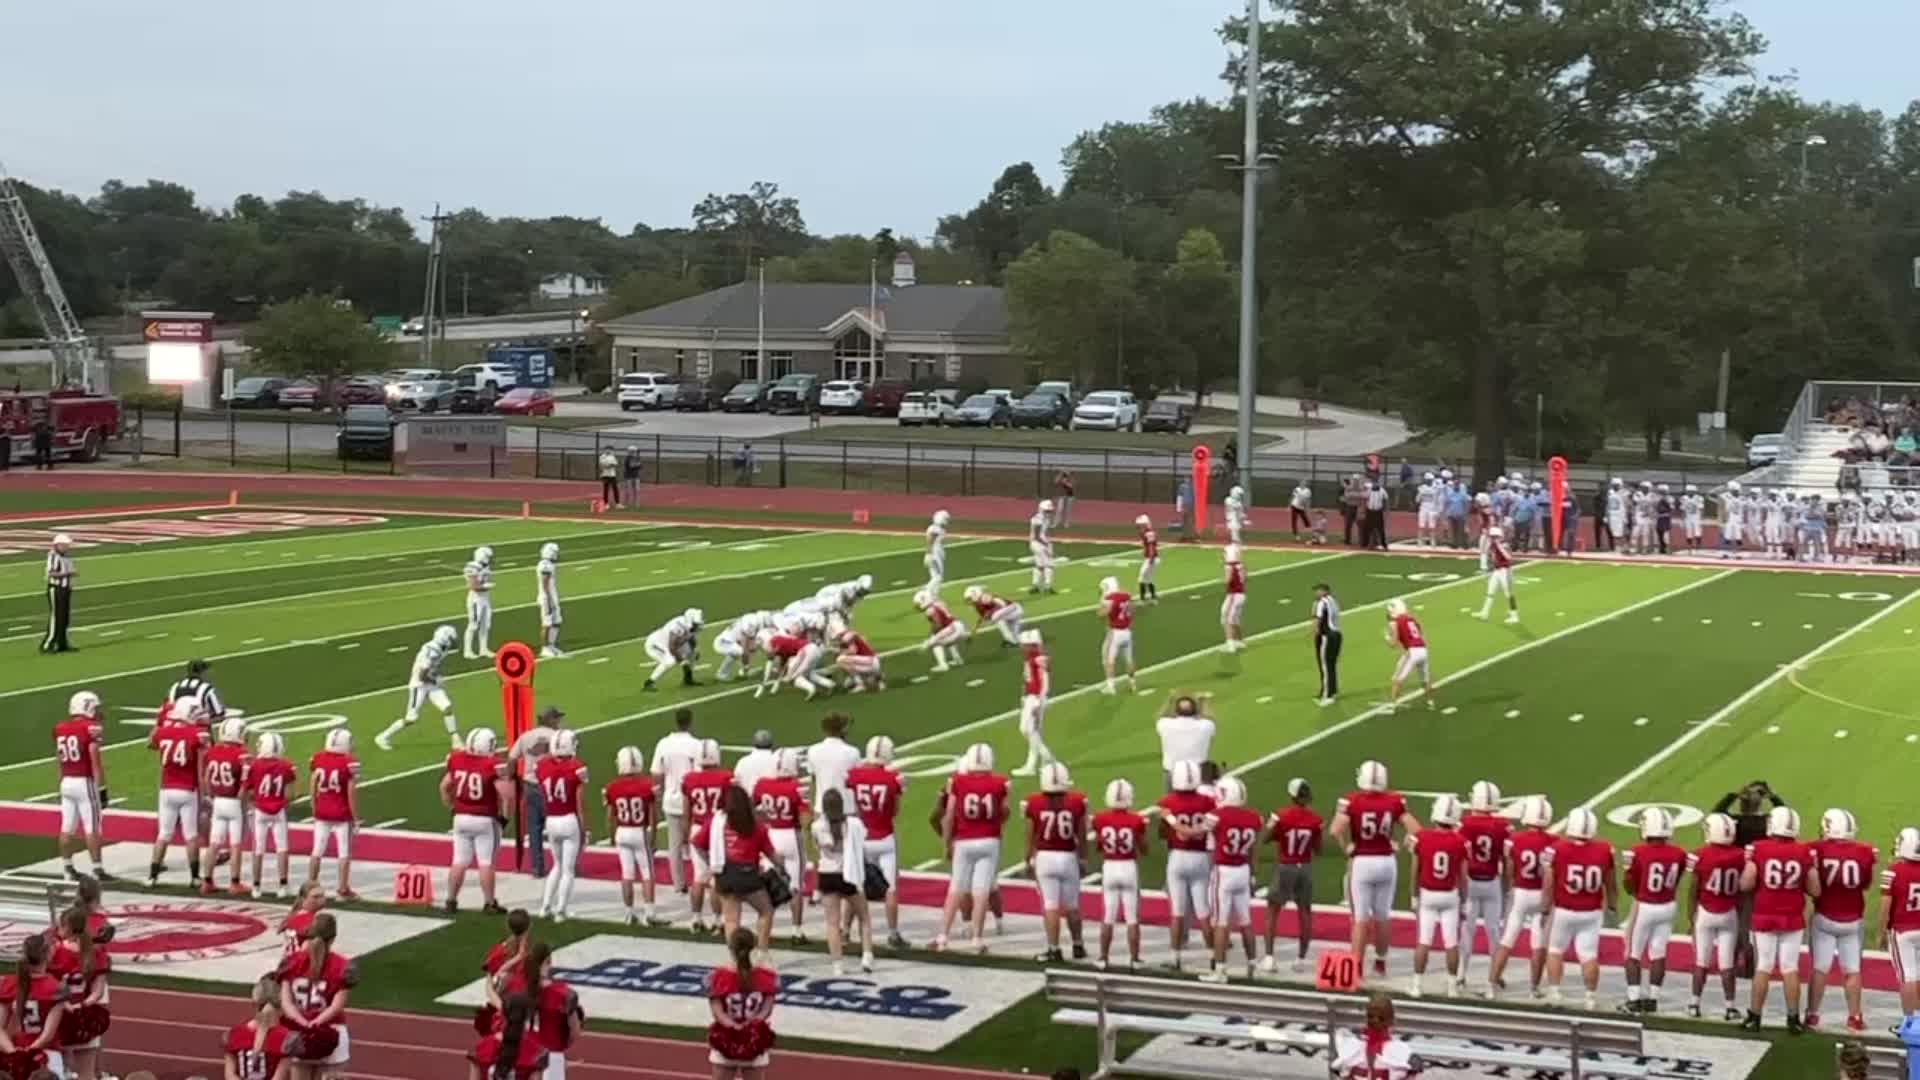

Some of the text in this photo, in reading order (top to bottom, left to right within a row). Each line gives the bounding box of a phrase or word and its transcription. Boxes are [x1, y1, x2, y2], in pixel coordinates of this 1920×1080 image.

[160, 738, 187, 767] 74
[207, 759, 235, 787] 26
[258, 773, 284, 799] 41
[316, 767, 342, 793] 24
[453, 770, 483, 801] 79
[544, 776, 568, 803] 14
[691, 787, 722, 815] 37
[857, 783, 888, 812] 57
[964, 793, 994, 820] 61
[1040, 810, 1074, 841] 76
[1102, 826, 1134, 854] 33
[1360, 811, 1393, 840] 54
[1222, 827, 1257, 855] 32
[1284, 829, 1313, 856] 17
[1433, 851, 1450, 880] 9
[1564, 863, 1603, 894] 50
[1648, 854, 1680, 893] 64
[1764, 859, 1802, 889] 62
[1823, 859, 1860, 890] 70
[397, 871, 426, 900] 30
[1705, 867, 1740, 897] 40
[1319, 956, 1356, 988] 40
